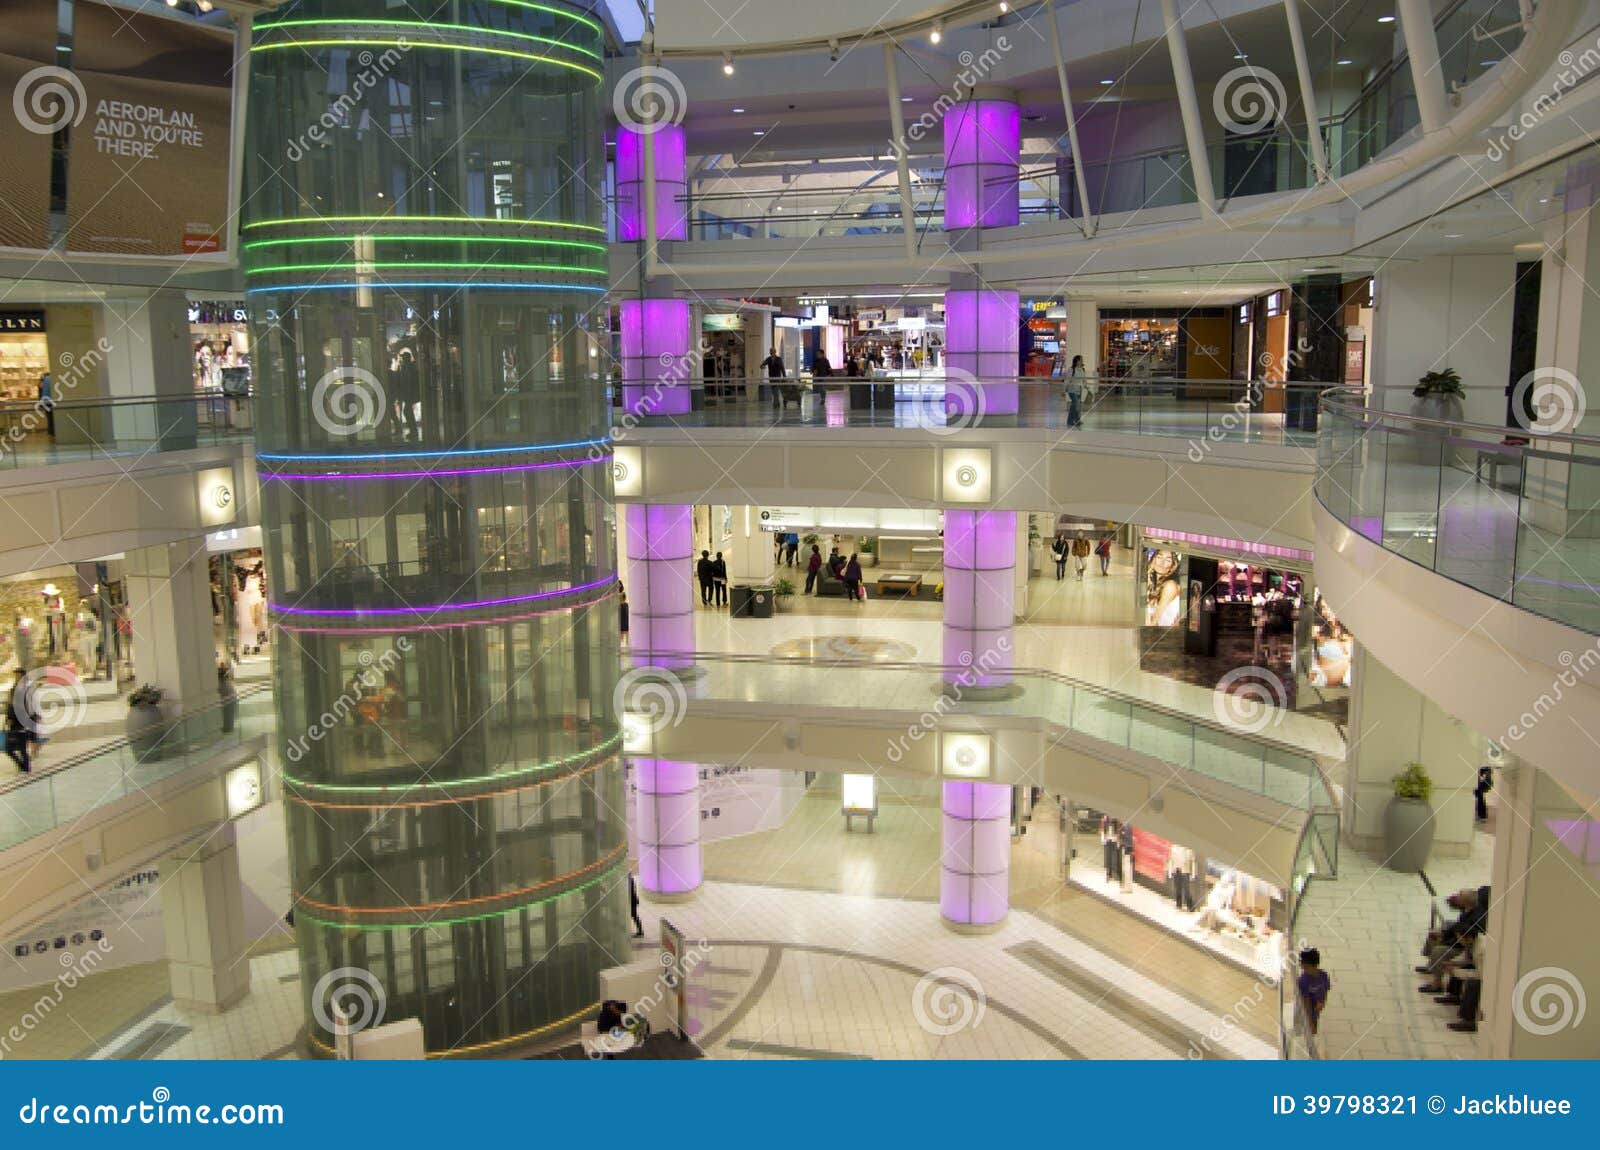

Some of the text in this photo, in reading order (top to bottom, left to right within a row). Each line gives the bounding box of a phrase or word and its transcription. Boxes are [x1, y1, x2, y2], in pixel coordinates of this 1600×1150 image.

[96, 100, 198, 129] AEROPLAN.
[95, 118, 203, 147] AND YOU'RE
[94, 136, 159, 159] THERE.
[0, 319, 40, 329] LYN
